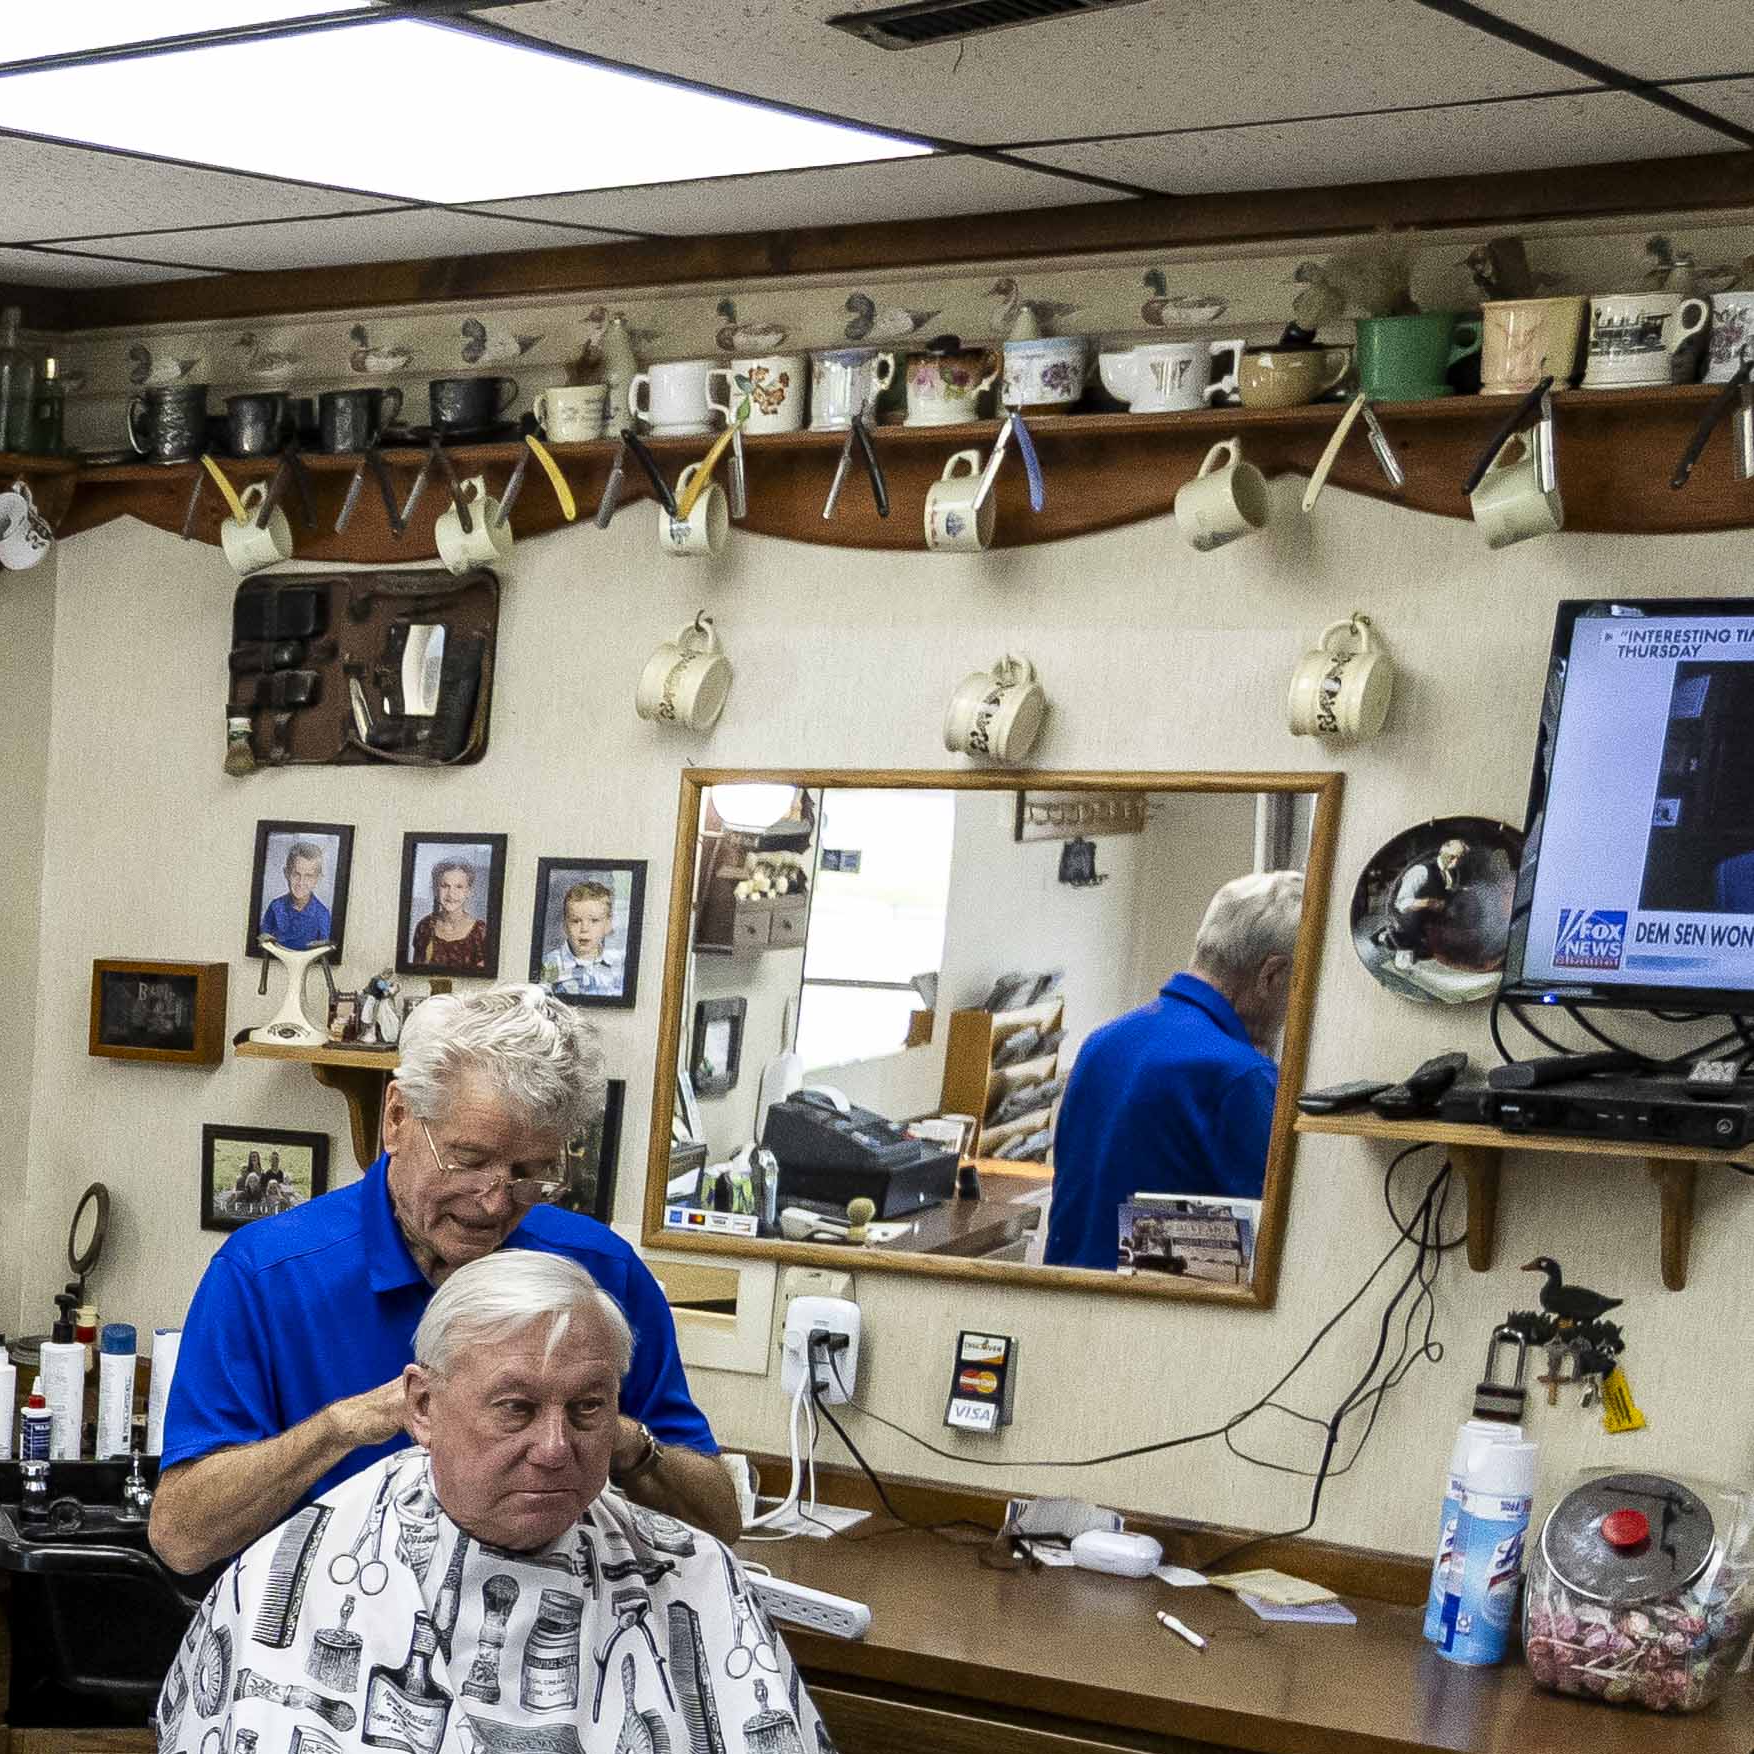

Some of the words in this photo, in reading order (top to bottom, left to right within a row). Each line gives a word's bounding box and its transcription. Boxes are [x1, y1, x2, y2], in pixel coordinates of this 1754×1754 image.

[1617, 643, 1702, 658] THURSDAY
[1581, 921, 1624, 942] FOX
[1635, 922, 1671, 944] DEM
[1674, 924, 1707, 945] SEN
[1565, 941, 1623, 958] NEWS
[954, 1404, 991, 1422] VISA
